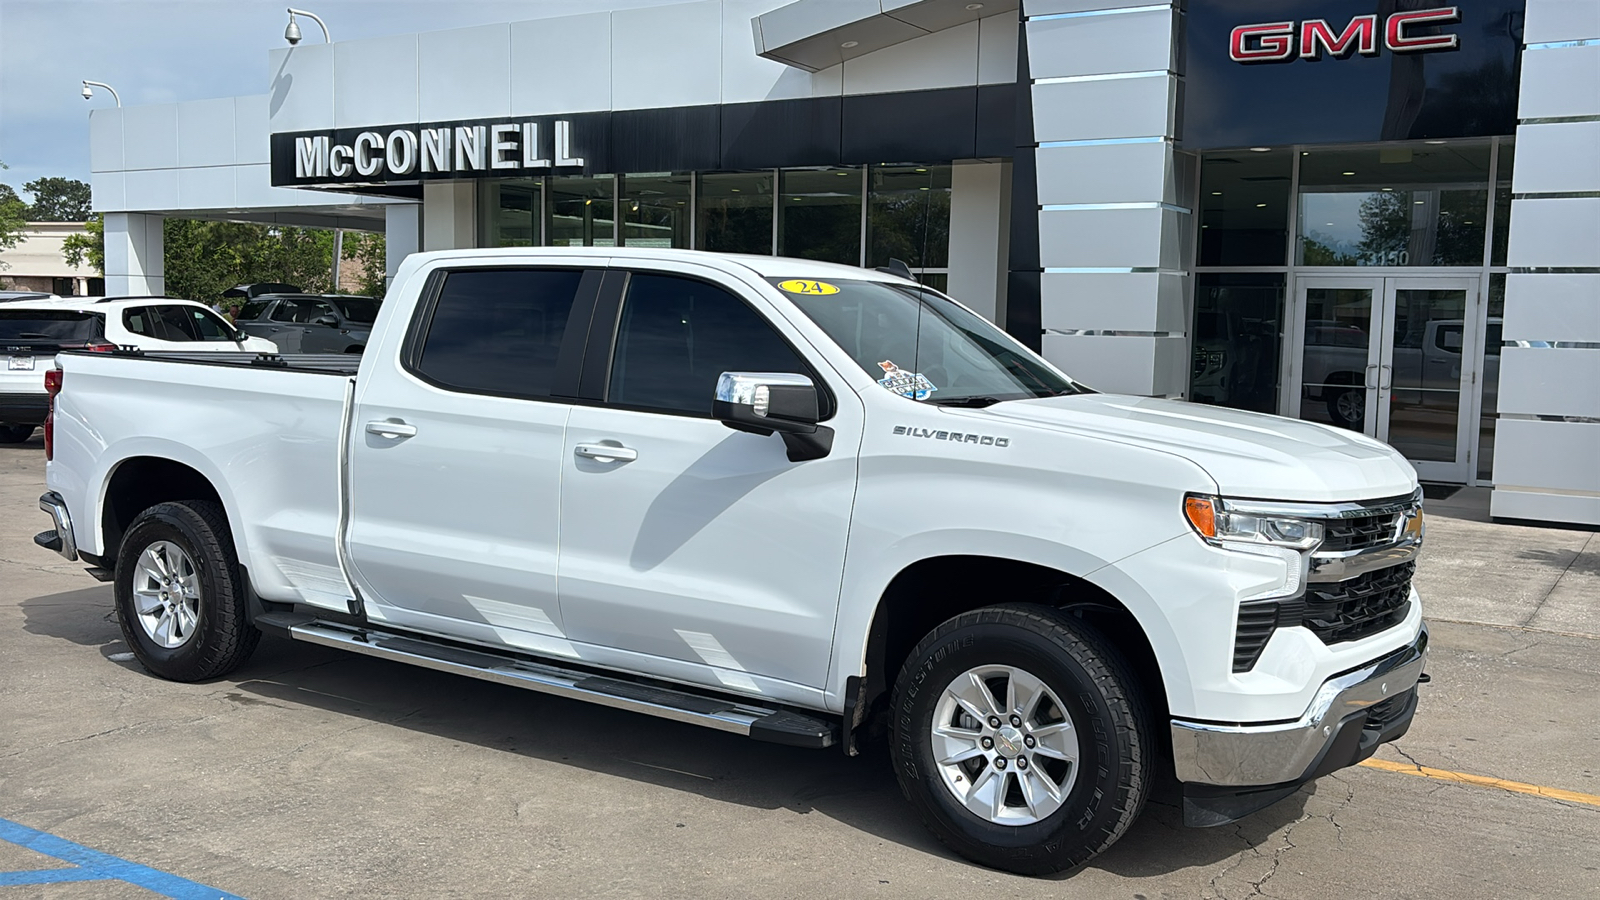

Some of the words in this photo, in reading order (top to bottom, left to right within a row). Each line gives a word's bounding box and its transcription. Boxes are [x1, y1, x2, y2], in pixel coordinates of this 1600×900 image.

[1229, 6, 1458, 62] GMC
[295, 120, 585, 178] McCONNELL
[1366, 250, 1410, 266] 3150
[795, 281, 823, 294] 24
[892, 425, 1010, 447] SILVERADO
